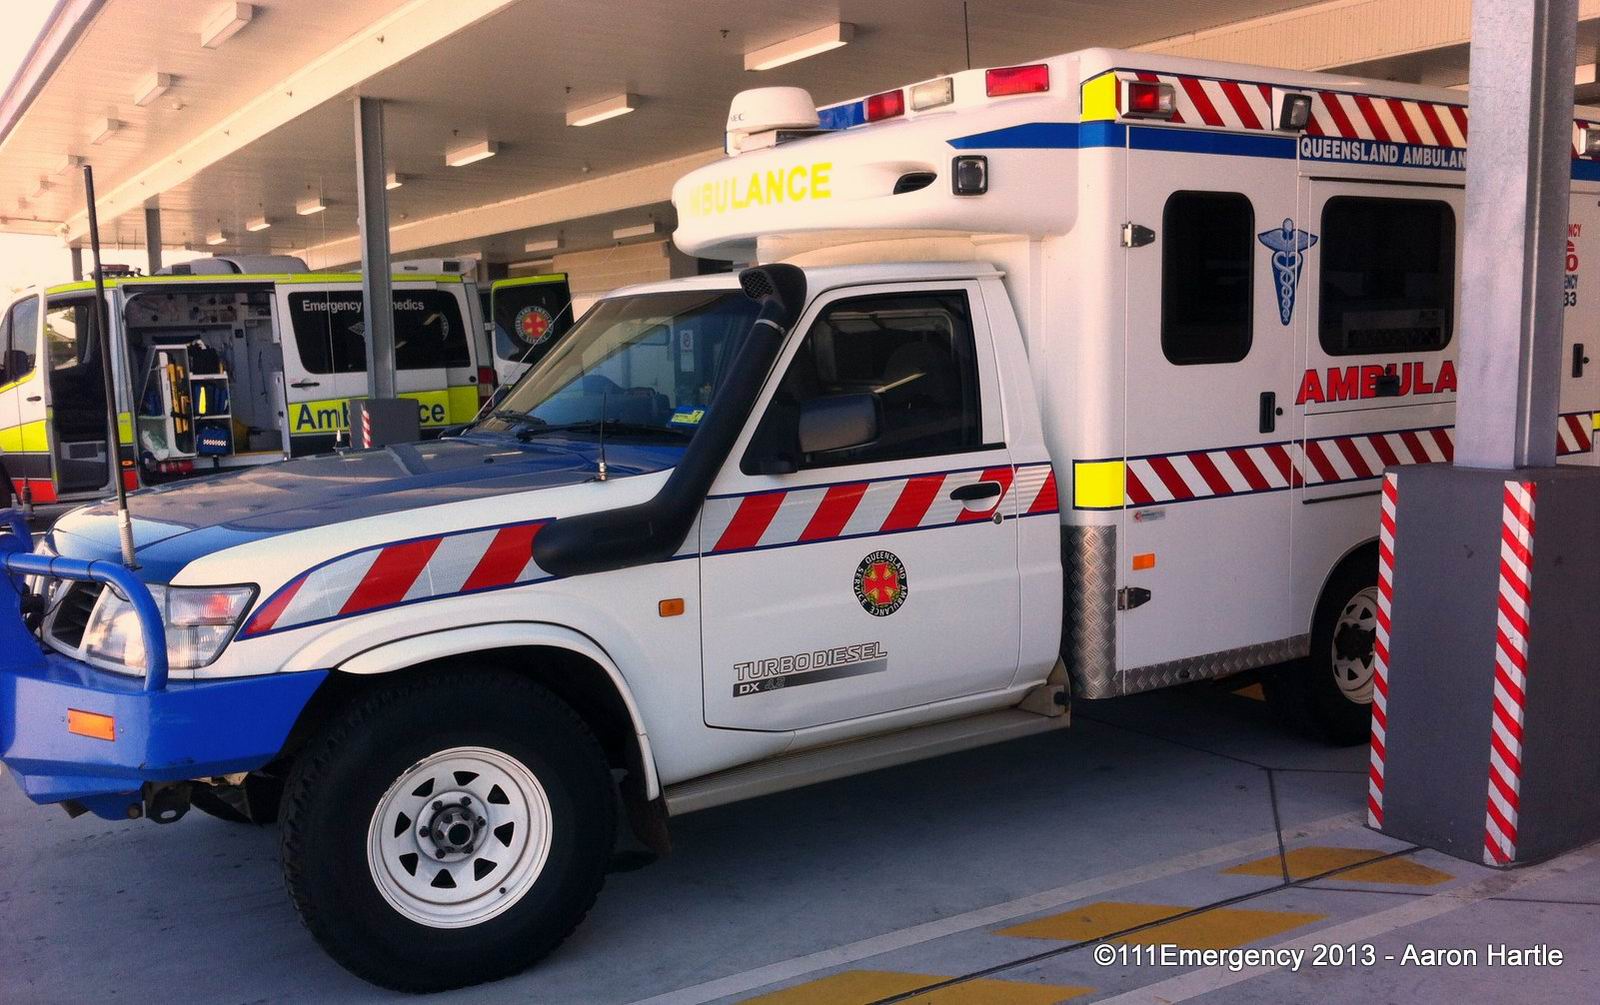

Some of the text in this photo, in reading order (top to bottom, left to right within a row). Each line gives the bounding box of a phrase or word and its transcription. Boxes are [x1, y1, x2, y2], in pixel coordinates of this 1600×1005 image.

[1301, 137, 1467, 169] QUEENSLAND AMBULAN
[302, 298, 425, 314] Emergency medics
[1295, 360, 1458, 406] AMBULA
[854, 551, 907, 616] QUEENSLAND AMBULANCE SERVICE
[739, 682, 760, 695] DX
